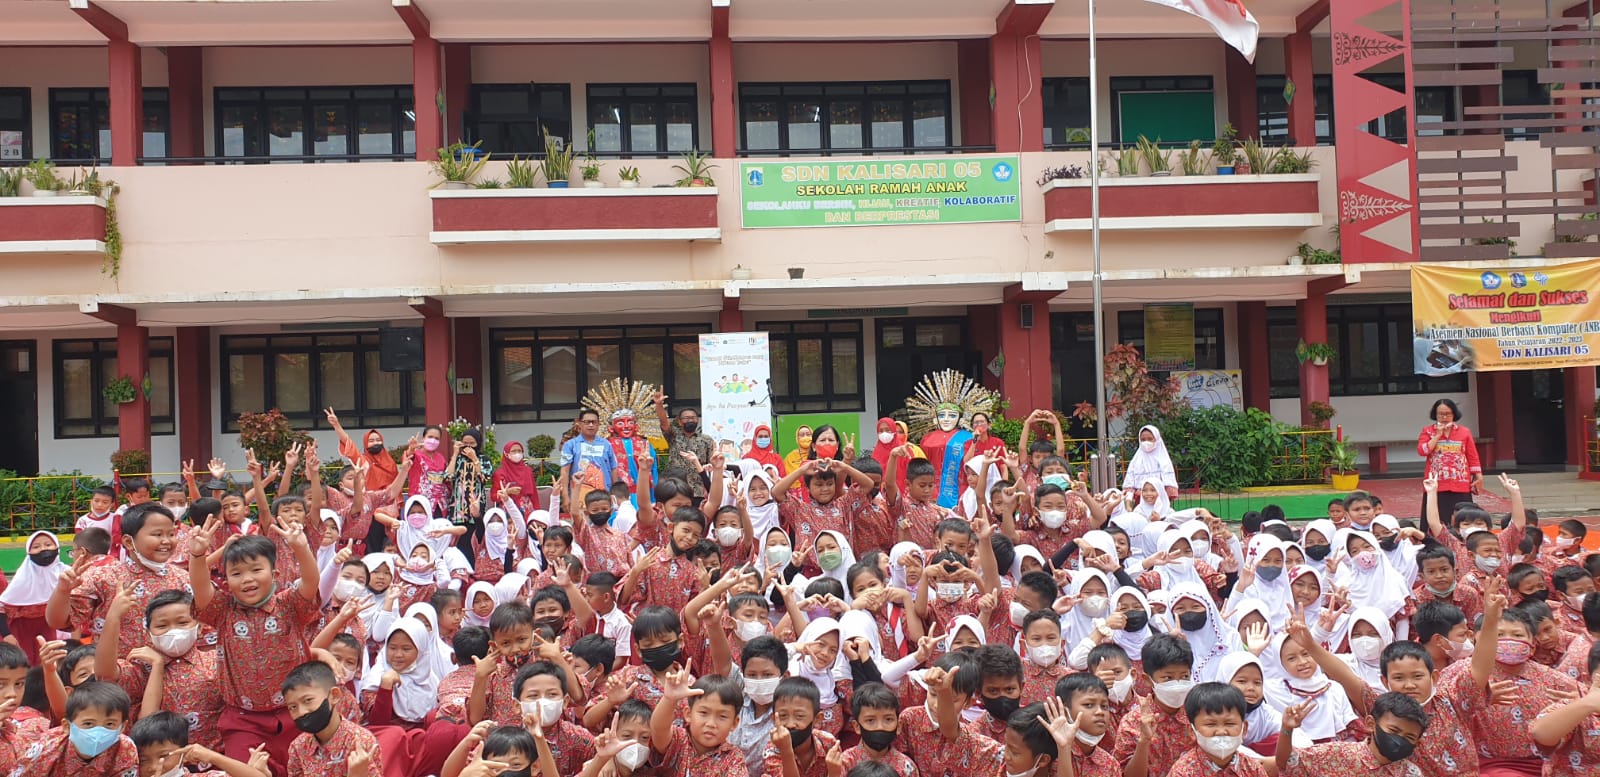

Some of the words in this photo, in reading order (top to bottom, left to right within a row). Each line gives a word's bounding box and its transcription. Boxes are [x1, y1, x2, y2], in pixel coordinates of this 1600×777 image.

[781, 166, 829, 182] SDN
[837, 163, 946, 181] KALISARI
[954, 161, 982, 178] 05
[797, 183, 865, 196] SEKOLAH
[869, 182, 921, 195] RAMAH
[926, 181, 968, 193] ANAK
[747, 200, 811, 210] SEKOLAHKU
[944, 195, 1016, 206] KOLABORATIF
[824, 212, 851, 223] DAN
[854, 210, 940, 222] BERPRESTASI
[1449, 292, 1505, 310] Selamat
[1508, 292, 1536, 307] dan
[1540, 290, 1588, 306] Sukses
[1490, 310, 1542, 324] Mengikuti
[1430, 328, 1463, 340] Asesmen
[1465, 327, 1499, 338] Nasional
[1501, 325, 1535, 336] Berbasis
[1536, 323, 1578, 335] Komputer
[1498, 339, 1515, 347] Tahun
[1517, 338, 1547, 346] Pelajaran
[1501, 349, 1522, 358] SDN
[1524, 346, 1571, 357] KALISARI
[1574, 345, 1589, 355] 05
